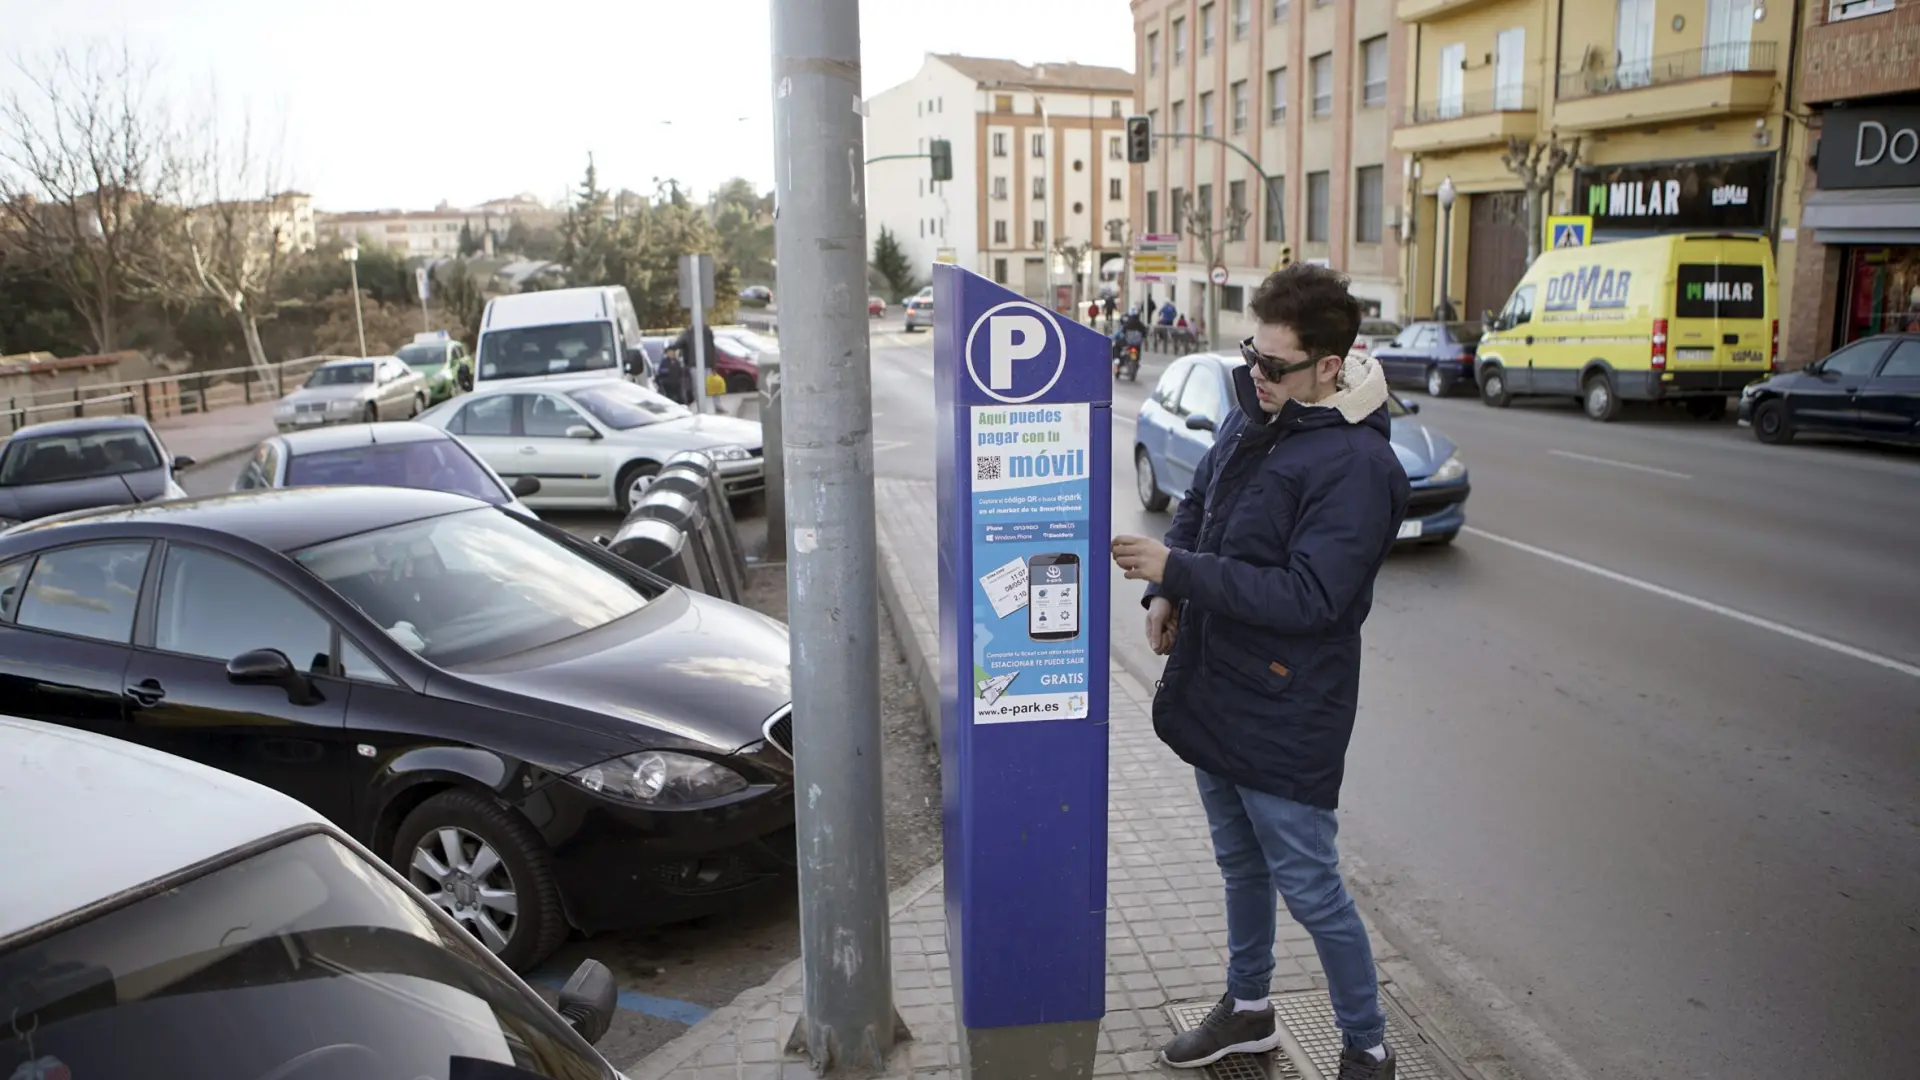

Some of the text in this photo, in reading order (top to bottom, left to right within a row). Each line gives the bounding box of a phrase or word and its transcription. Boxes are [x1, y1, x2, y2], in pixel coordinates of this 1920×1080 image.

[1609, 180, 1681, 217] MILAR
[1544, 264, 1632, 312] DOMAR
[1703, 281, 1754, 302] MILAR
[990, 315, 1047, 390] P
[978, 409, 1062, 425] Aquí puedes
[977, 430, 1060, 446] pagar con tu
[1009, 449, 1084, 478] móvil
[1004, 496, 1026, 505] código
[1027, 495, 1038, 503] QR
[1057, 493, 1082, 503] e-park
[996, 506, 1020, 514] market
[1021, 505, 1030, 513] de
[991, 660, 1035, 669] ESTACIONAR
[1043, 658, 1065, 666] PUEDE
[1066, 657, 1085, 665] SALIR
[1040, 672, 1084, 686] GRATIS
[978, 702, 1059, 716] www.e-park.es
